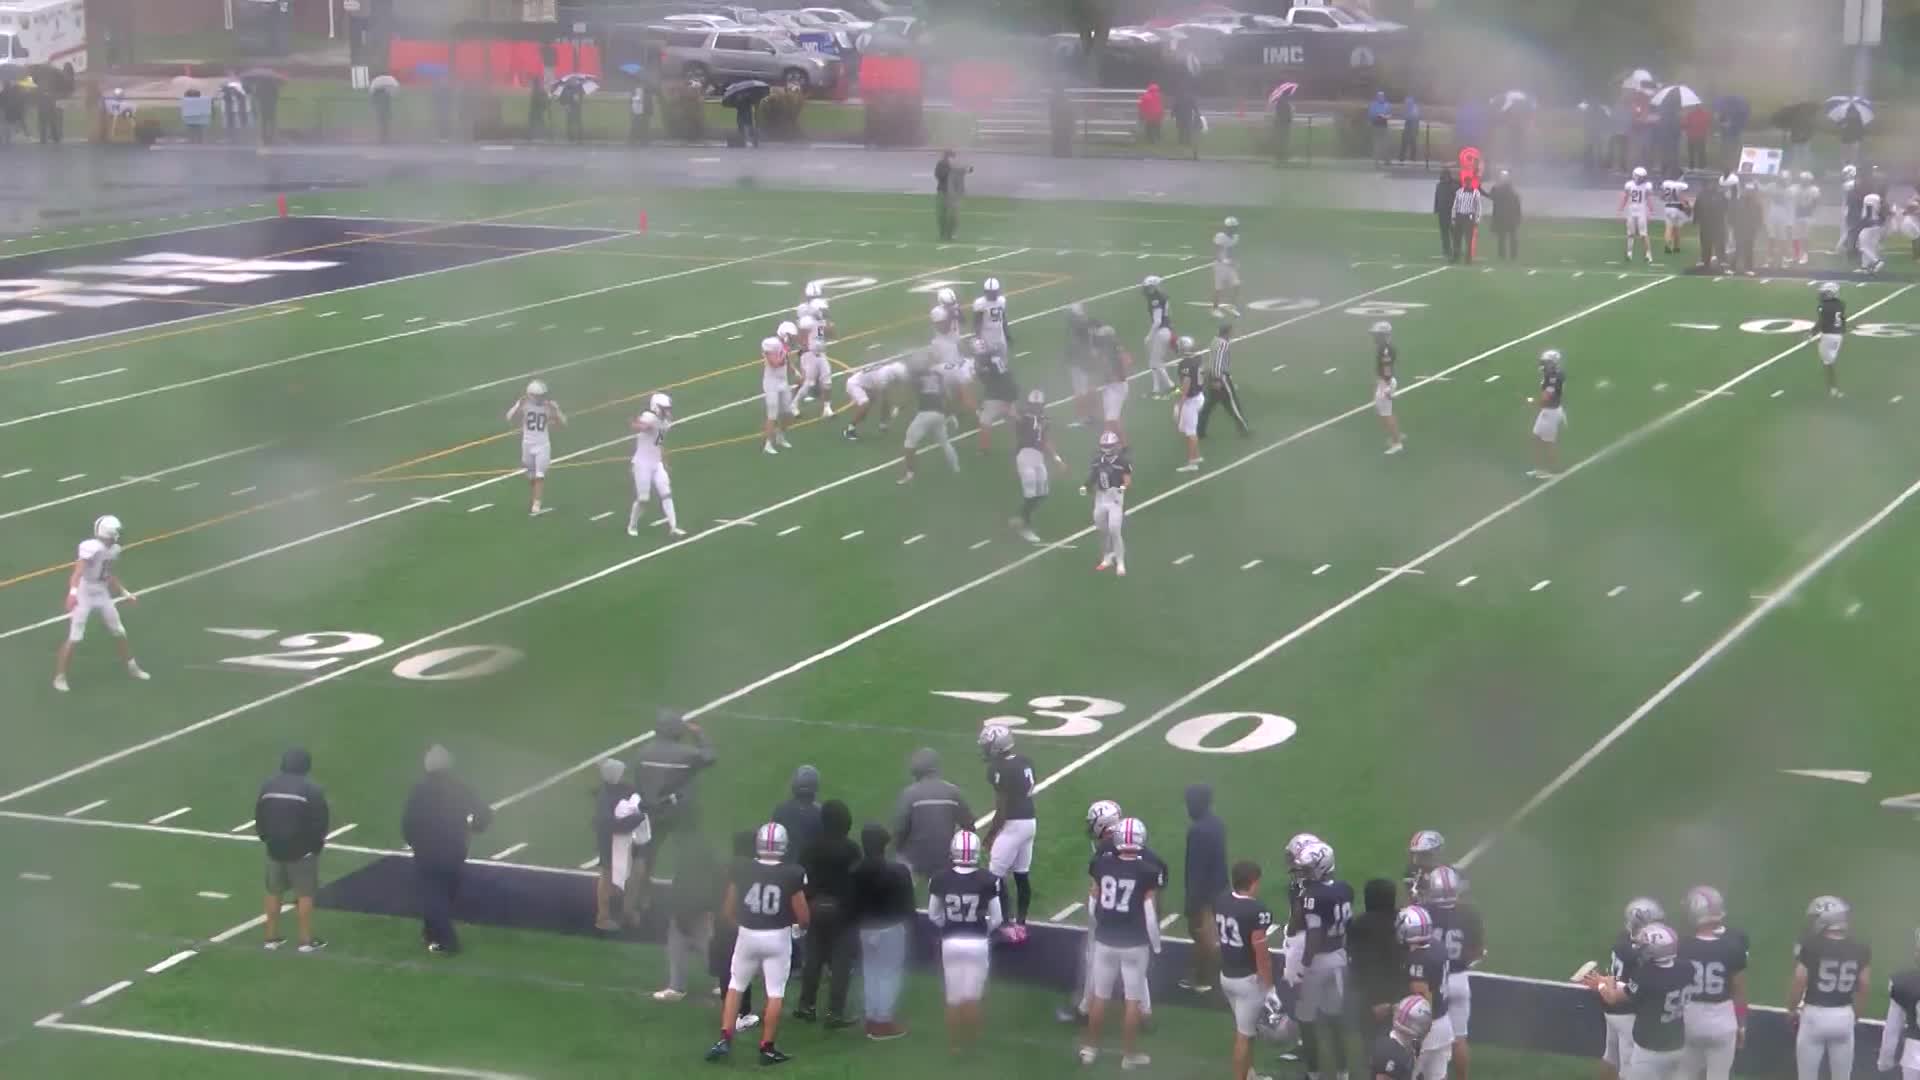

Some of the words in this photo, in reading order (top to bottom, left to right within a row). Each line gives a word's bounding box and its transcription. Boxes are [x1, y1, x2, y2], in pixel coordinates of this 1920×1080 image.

[1263, 46, 1304, 65] IMC
[527, 411, 547, 433] 20
[743, 882, 782, 915] 40
[944, 893, 981, 923] 27
[1100, 875, 1137, 912] 87
[1817, 959, 1860, 993] 56
